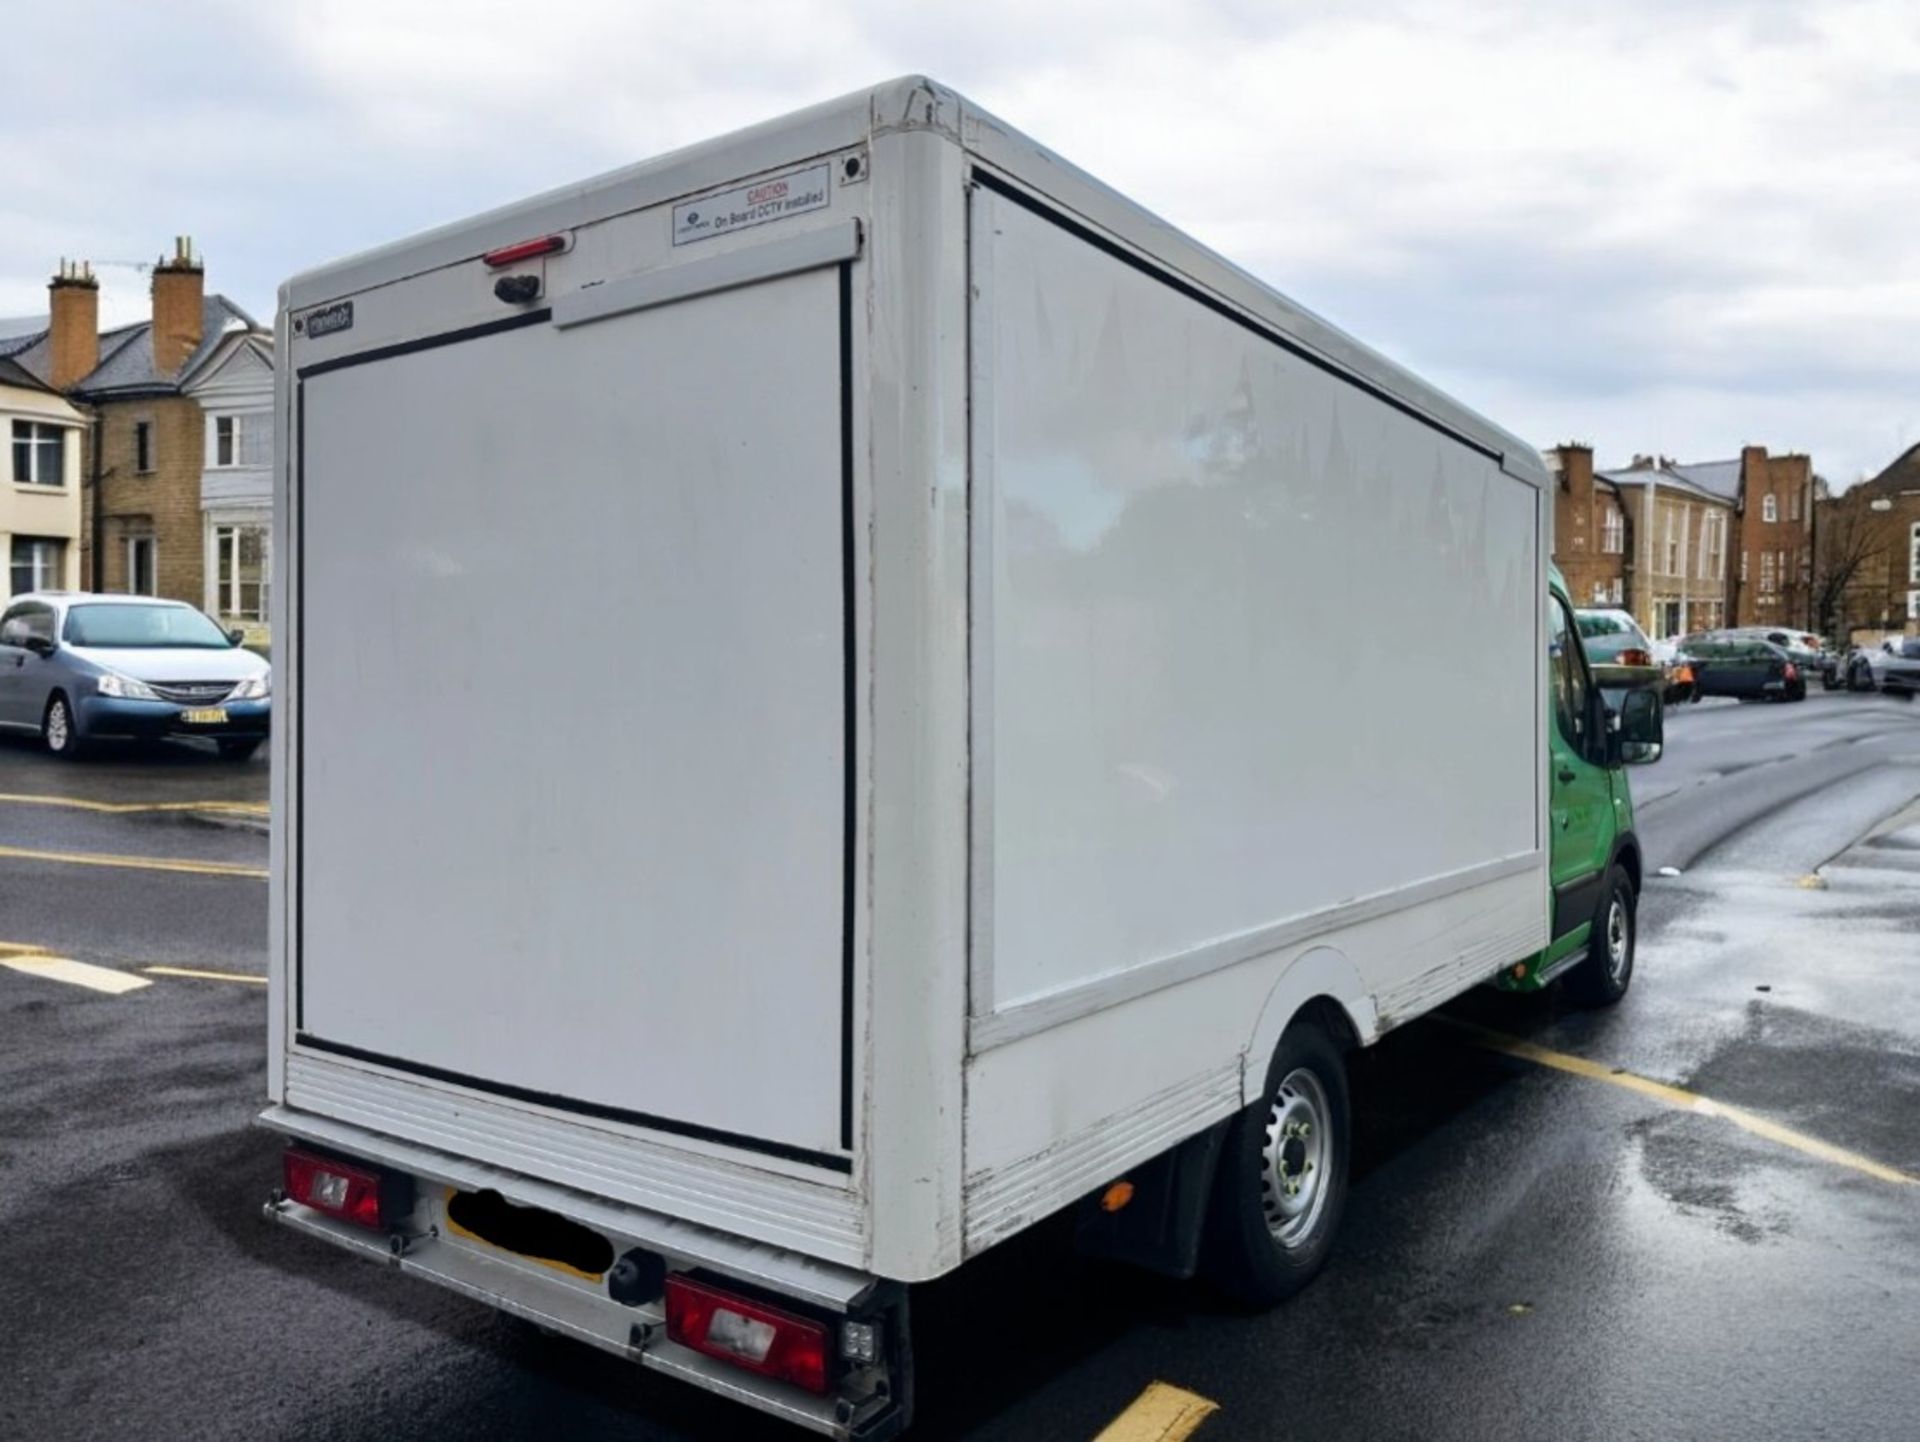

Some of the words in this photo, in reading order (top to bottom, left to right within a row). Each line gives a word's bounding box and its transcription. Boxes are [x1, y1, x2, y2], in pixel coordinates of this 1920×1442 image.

[747, 181, 789, 205] CAUTION
[715, 216, 728, 228] On
[730, 208, 756, 225] Board
[758, 200, 782, 218] CCTV
